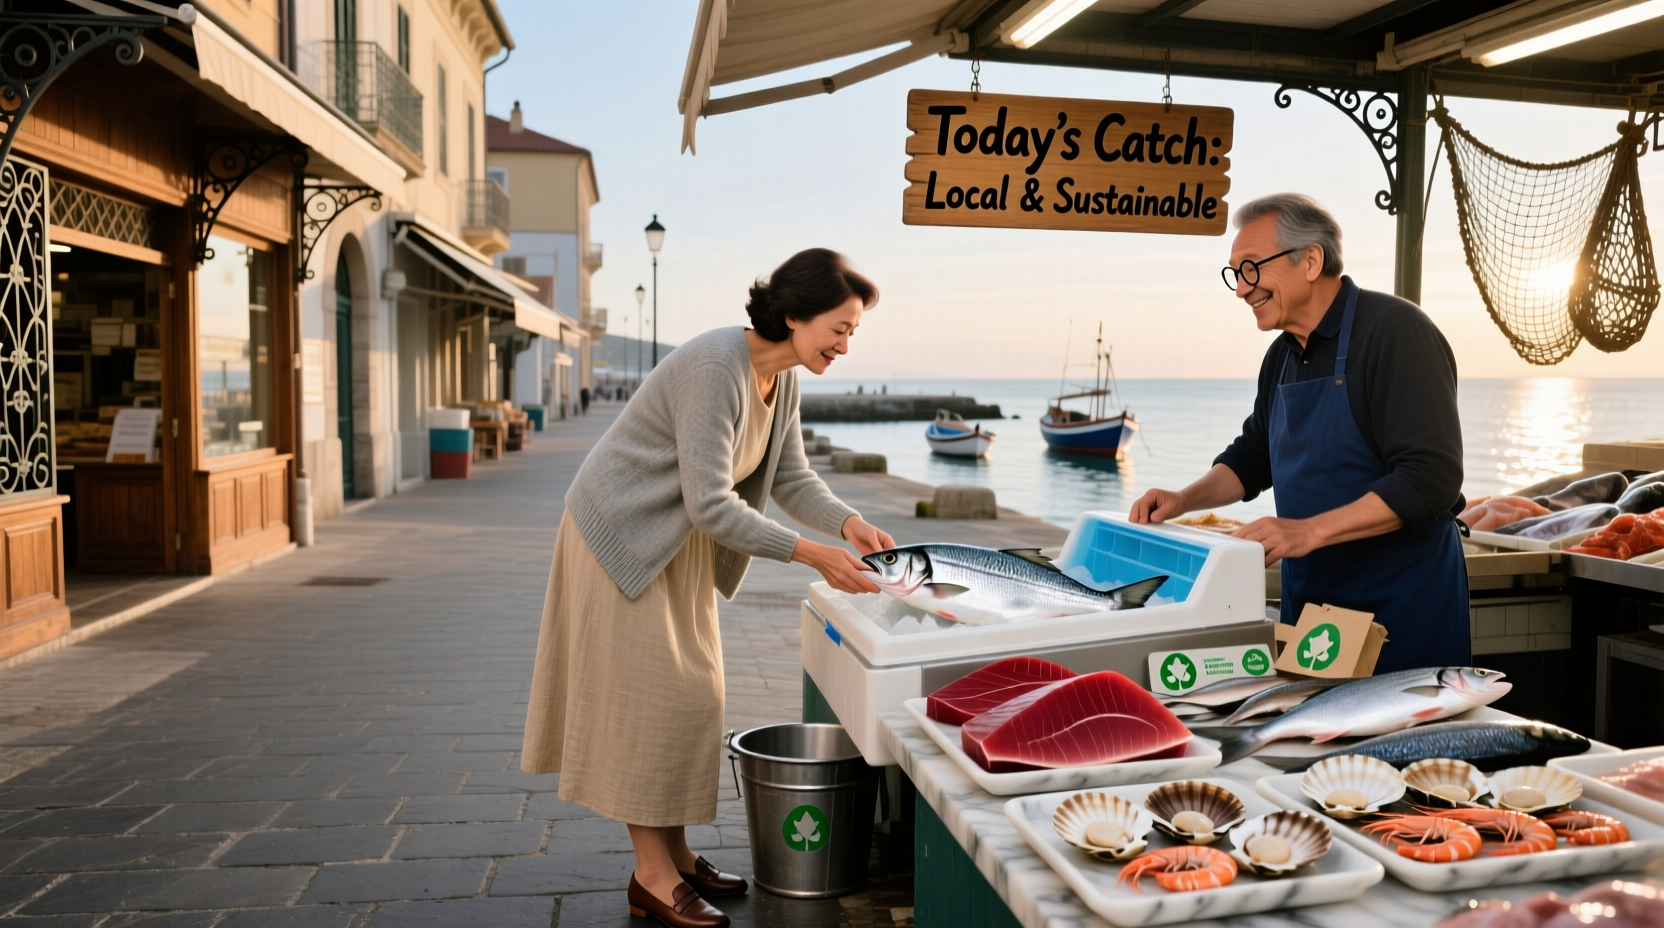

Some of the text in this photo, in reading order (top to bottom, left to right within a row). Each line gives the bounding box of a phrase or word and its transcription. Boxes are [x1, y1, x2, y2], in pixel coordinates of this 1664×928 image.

[928, 106, 1222, 175] Today's Catch:
[925, 170, 1217, 219] Local & Sustainable
